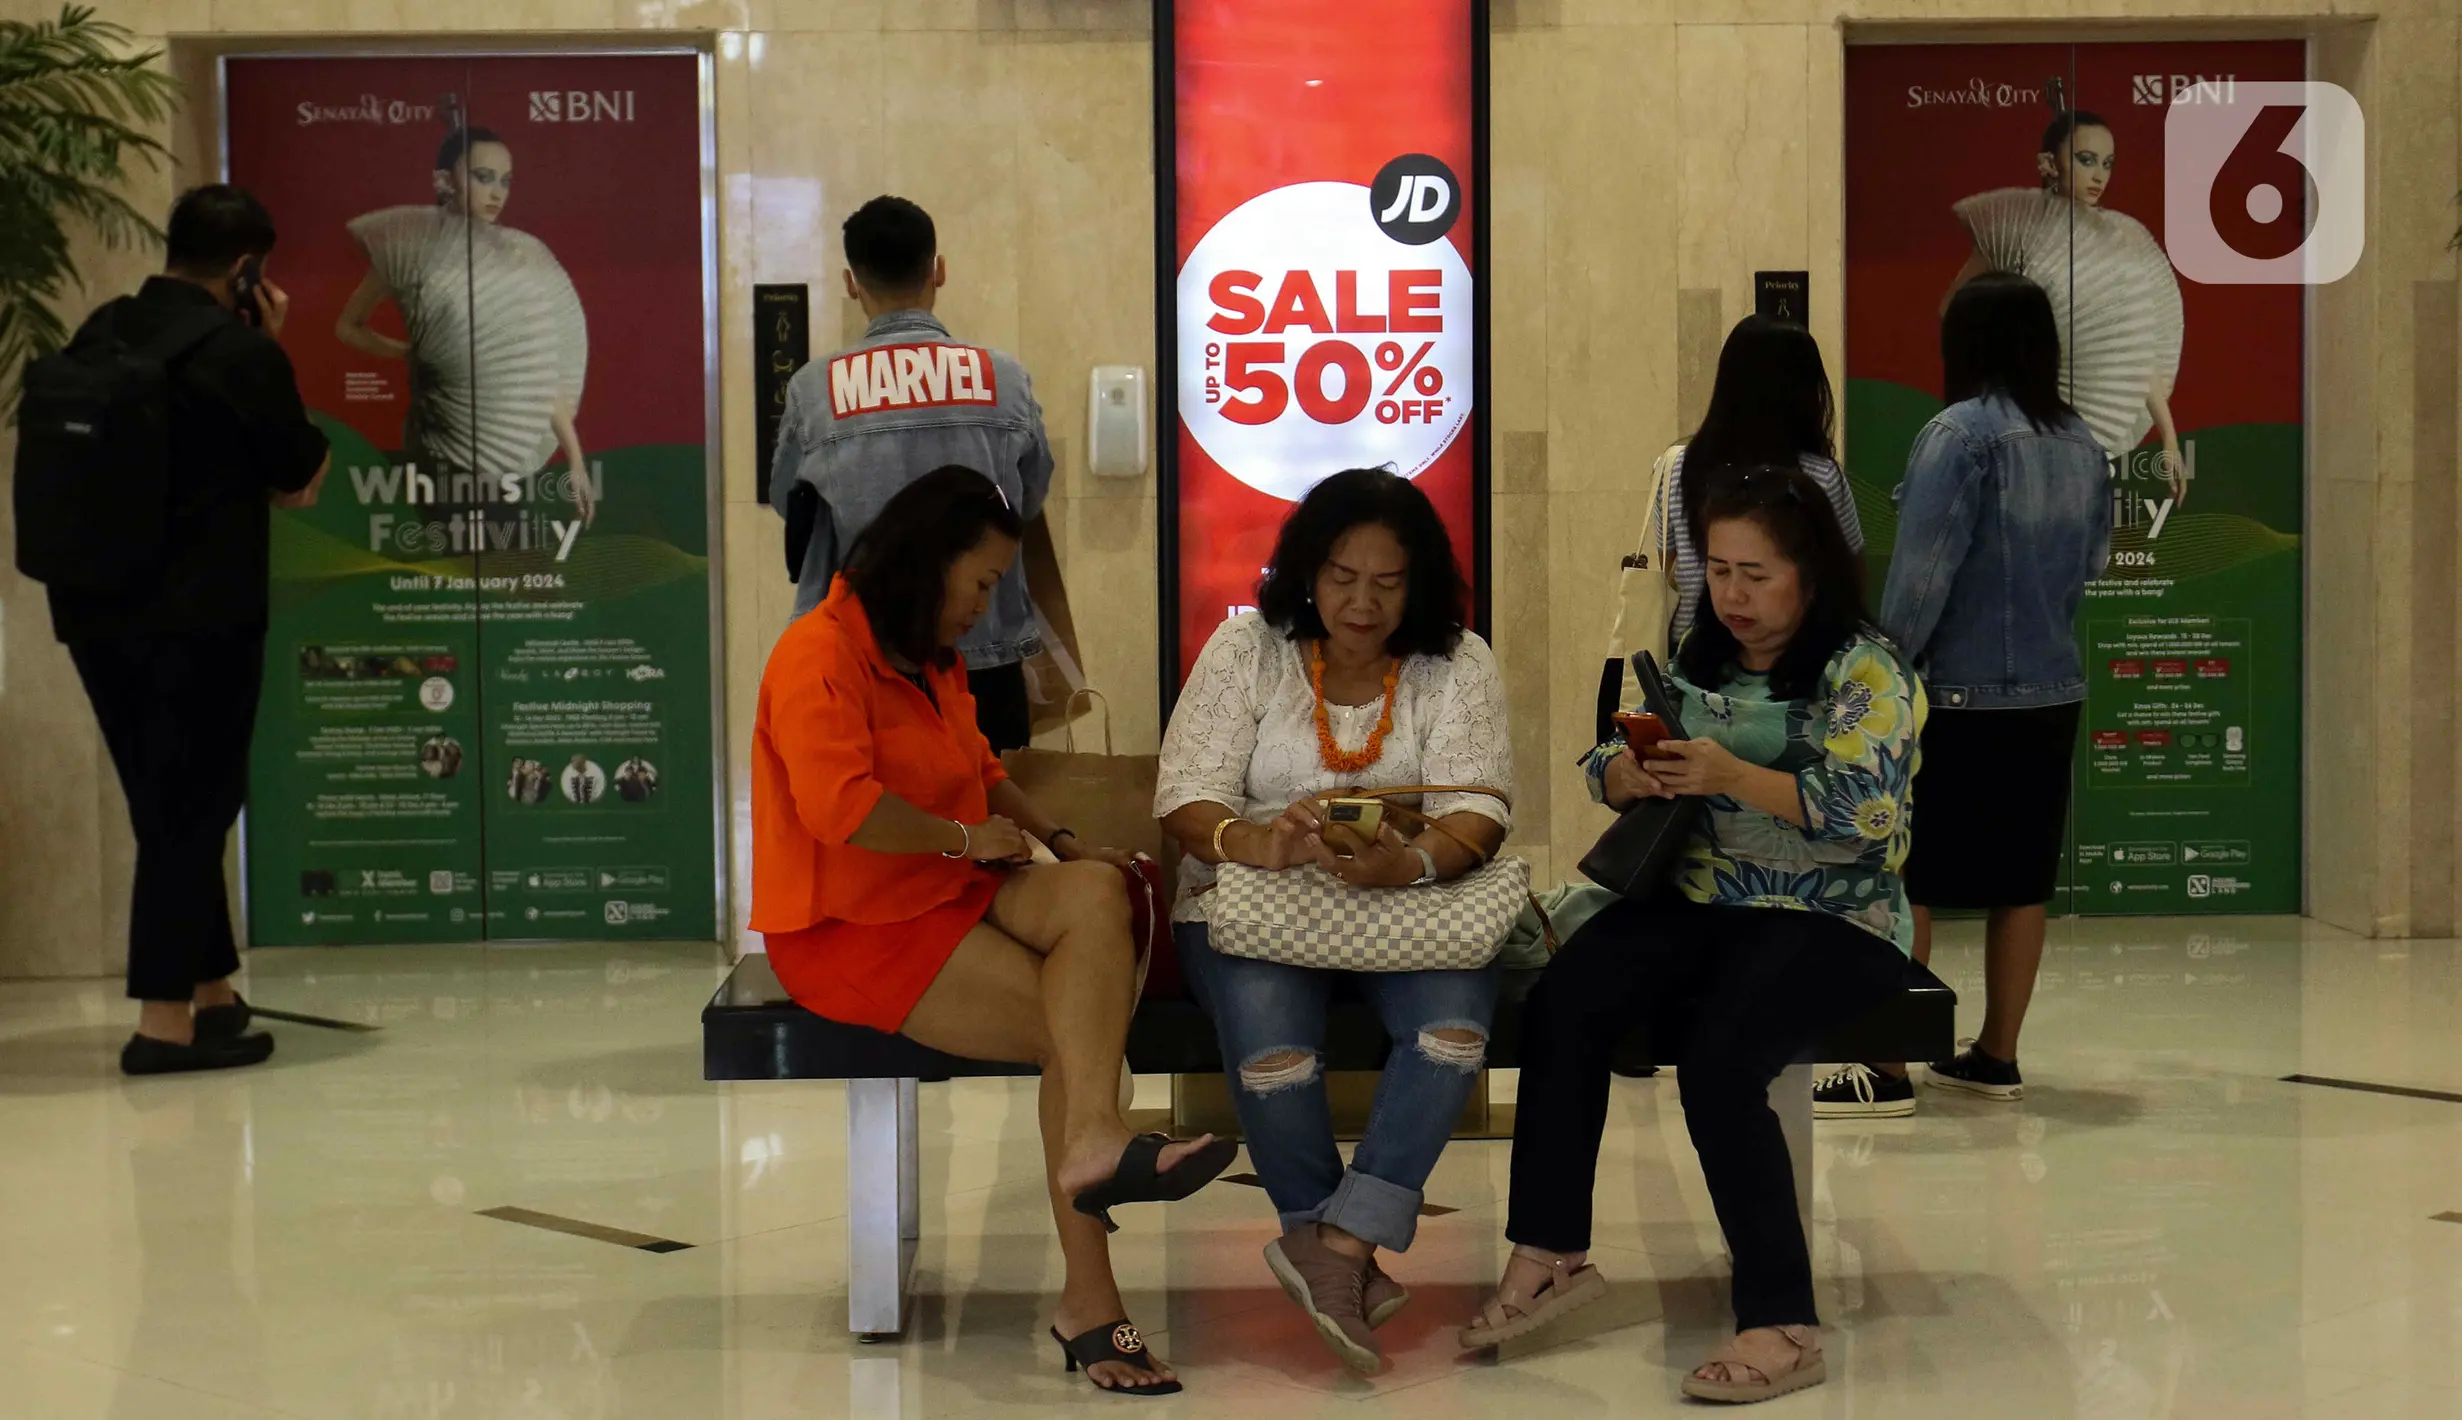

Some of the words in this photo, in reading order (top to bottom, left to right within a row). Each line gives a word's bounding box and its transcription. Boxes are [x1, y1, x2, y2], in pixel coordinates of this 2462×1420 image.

[1907, 77, 1992, 107] SENAYAN
[1996, 84, 2040, 107] CITY
[2169, 75, 2235, 105] BNI
[297, 94, 383, 126] SENAYAN
[388, 100, 435, 124] CITY
[567, 91, 635, 122] BNI
[1380, 175, 1451, 223] JD
[1206, 269, 1443, 335] SALE
[1205, 342, 1221, 369] TO
[832, 345, 992, 415] MARVEL
[1205, 376, 1221, 404] UP
[1217, 339, 1443, 425] 50%
[348, 460, 603, 505] Whimsical
[369, 509, 581, 561] Festivity
[2115, 551, 2156, 566] 2024
[390, 576, 430, 591] Until
[433, 576, 444, 589] 7
[446, 576, 519, 594] January
[522, 574, 566, 589] 2024
[551, 701, 599, 713] Midnight
[602, 701, 652, 713] Shopping
[2128, 851, 2146, 862] App
[2147, 850, 2172, 860] Store
[2201, 849, 2229, 860] Google
[2230, 848, 2247, 859] Play
